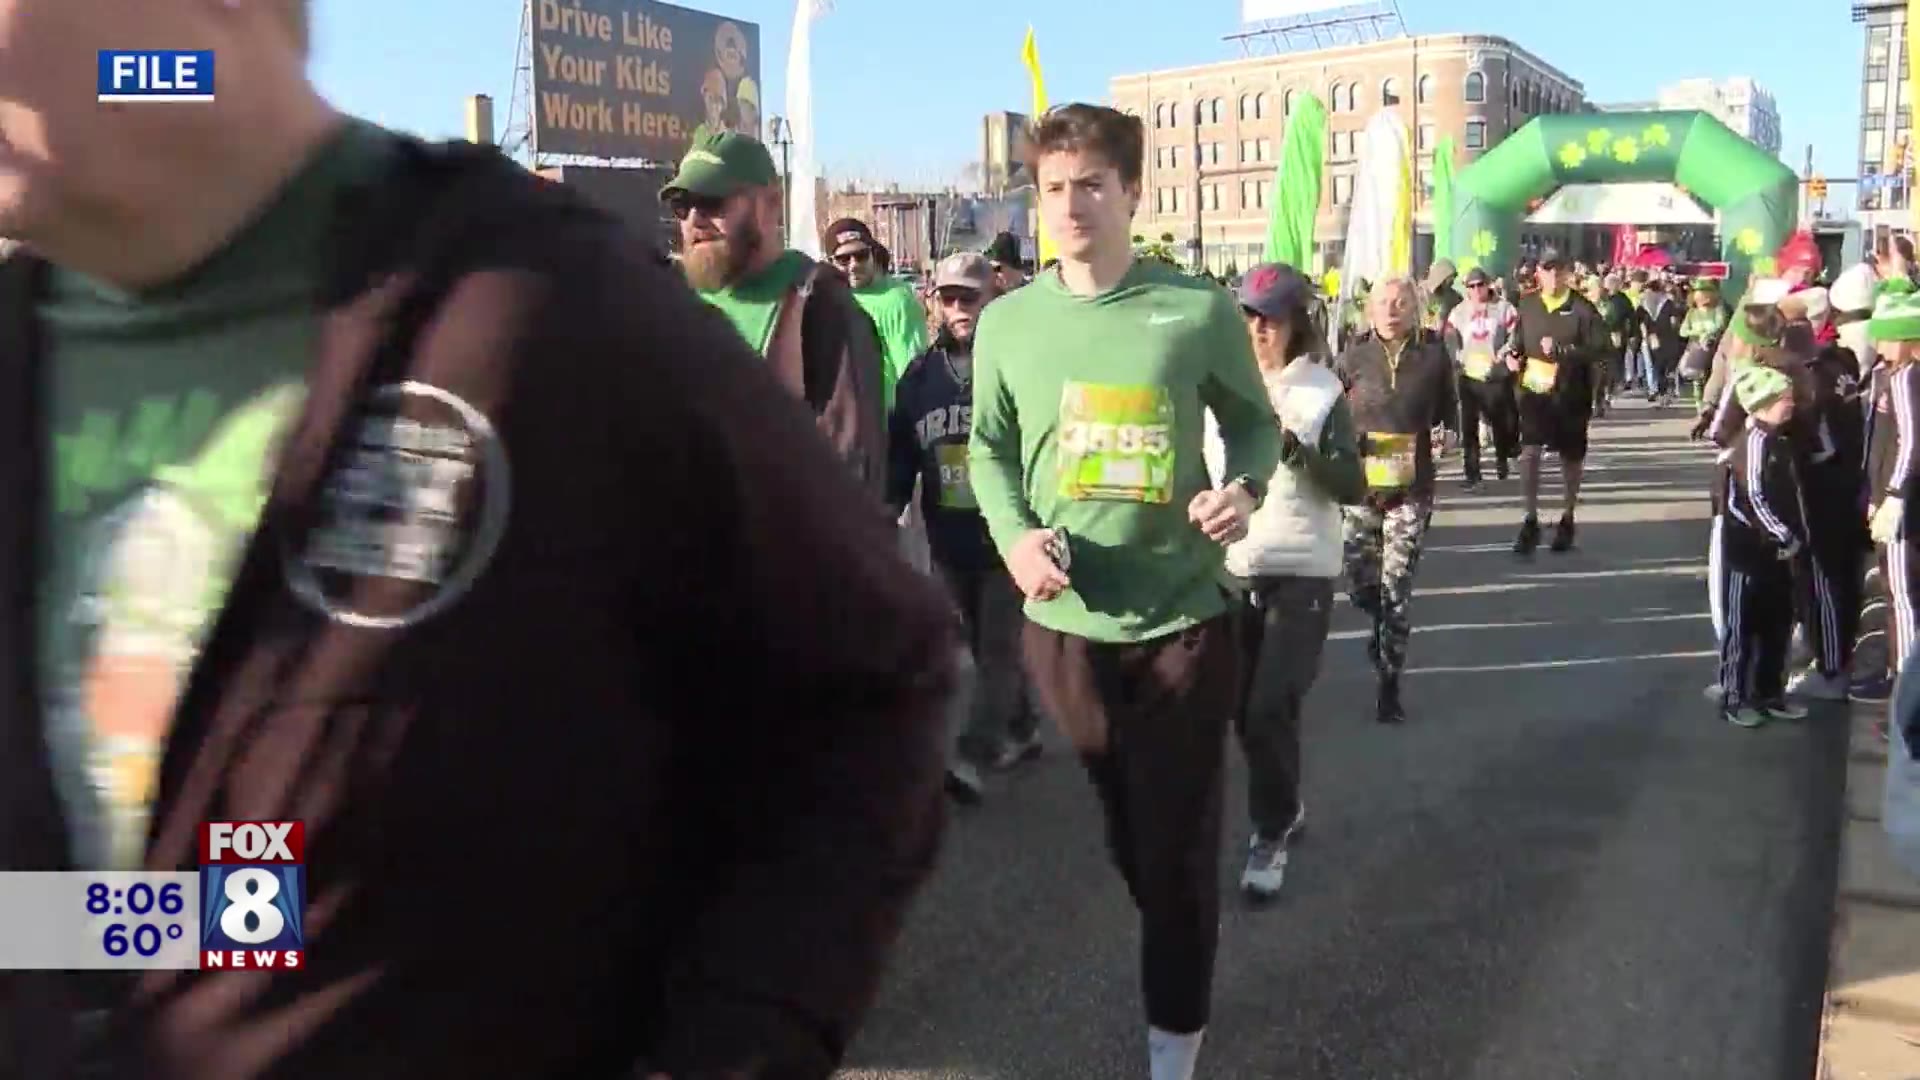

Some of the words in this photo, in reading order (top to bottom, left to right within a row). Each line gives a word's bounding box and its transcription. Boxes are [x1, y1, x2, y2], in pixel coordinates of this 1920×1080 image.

[538, 0, 612, 41] Drive
[622, 11, 673, 51] Like
[541, 42, 607, 86] Your
[616, 54, 671, 96] Kids
[541, 91, 614, 132] Work
